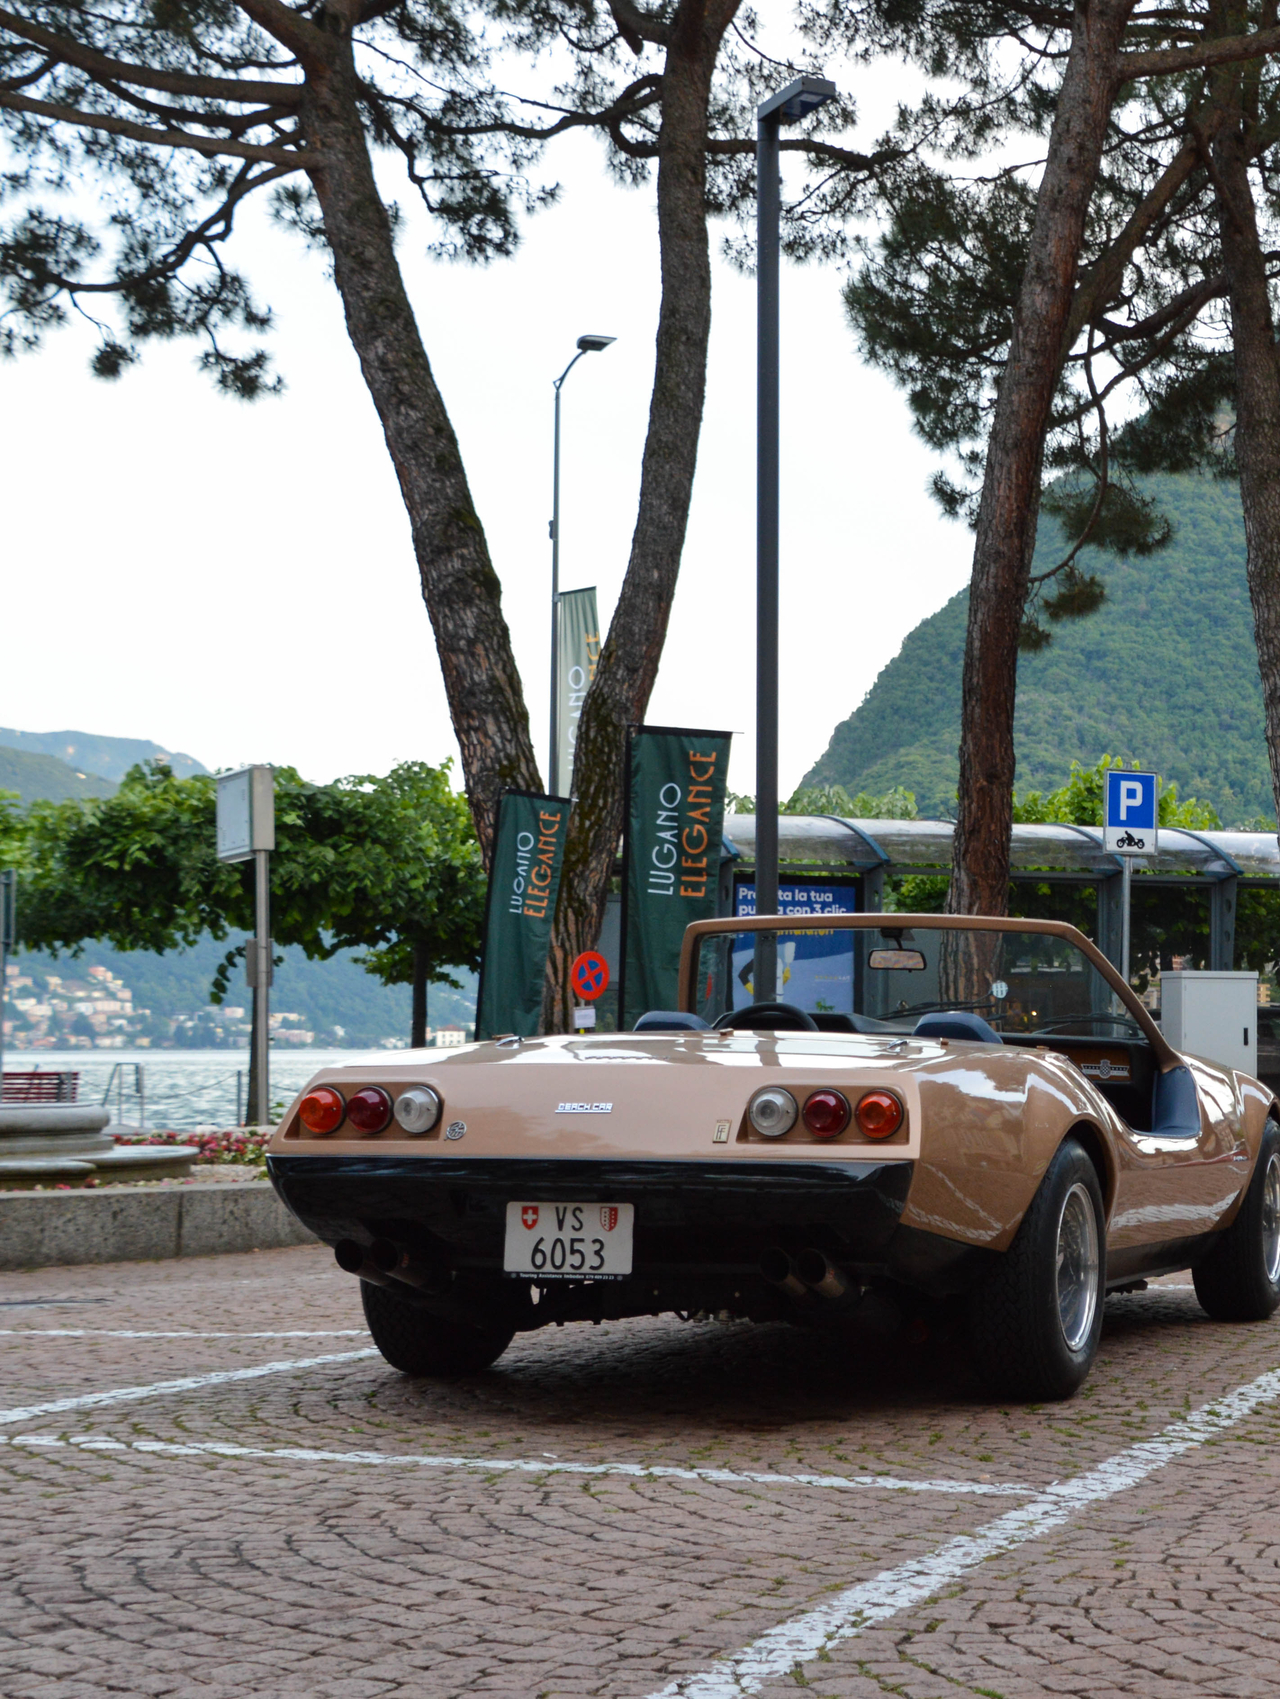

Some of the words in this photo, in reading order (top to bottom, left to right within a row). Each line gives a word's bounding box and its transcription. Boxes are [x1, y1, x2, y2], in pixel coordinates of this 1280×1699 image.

[1120, 780, 1143, 820] P
[648, 783, 681, 895] LUGANO
[680, 751, 716, 897] ELEGANCE
[509, 832, 534, 914] LUGANO
[524, 811, 561, 918] ELEGANCE
[786, 906, 810, 915] con
[813, 904, 821, 915] 3
[824, 904, 846, 914] clic
[795, 889, 807, 901] la
[810, 891, 833, 902] tua
[555, 1206, 583, 1232] VS
[531, 1237, 605, 1271] 6053
